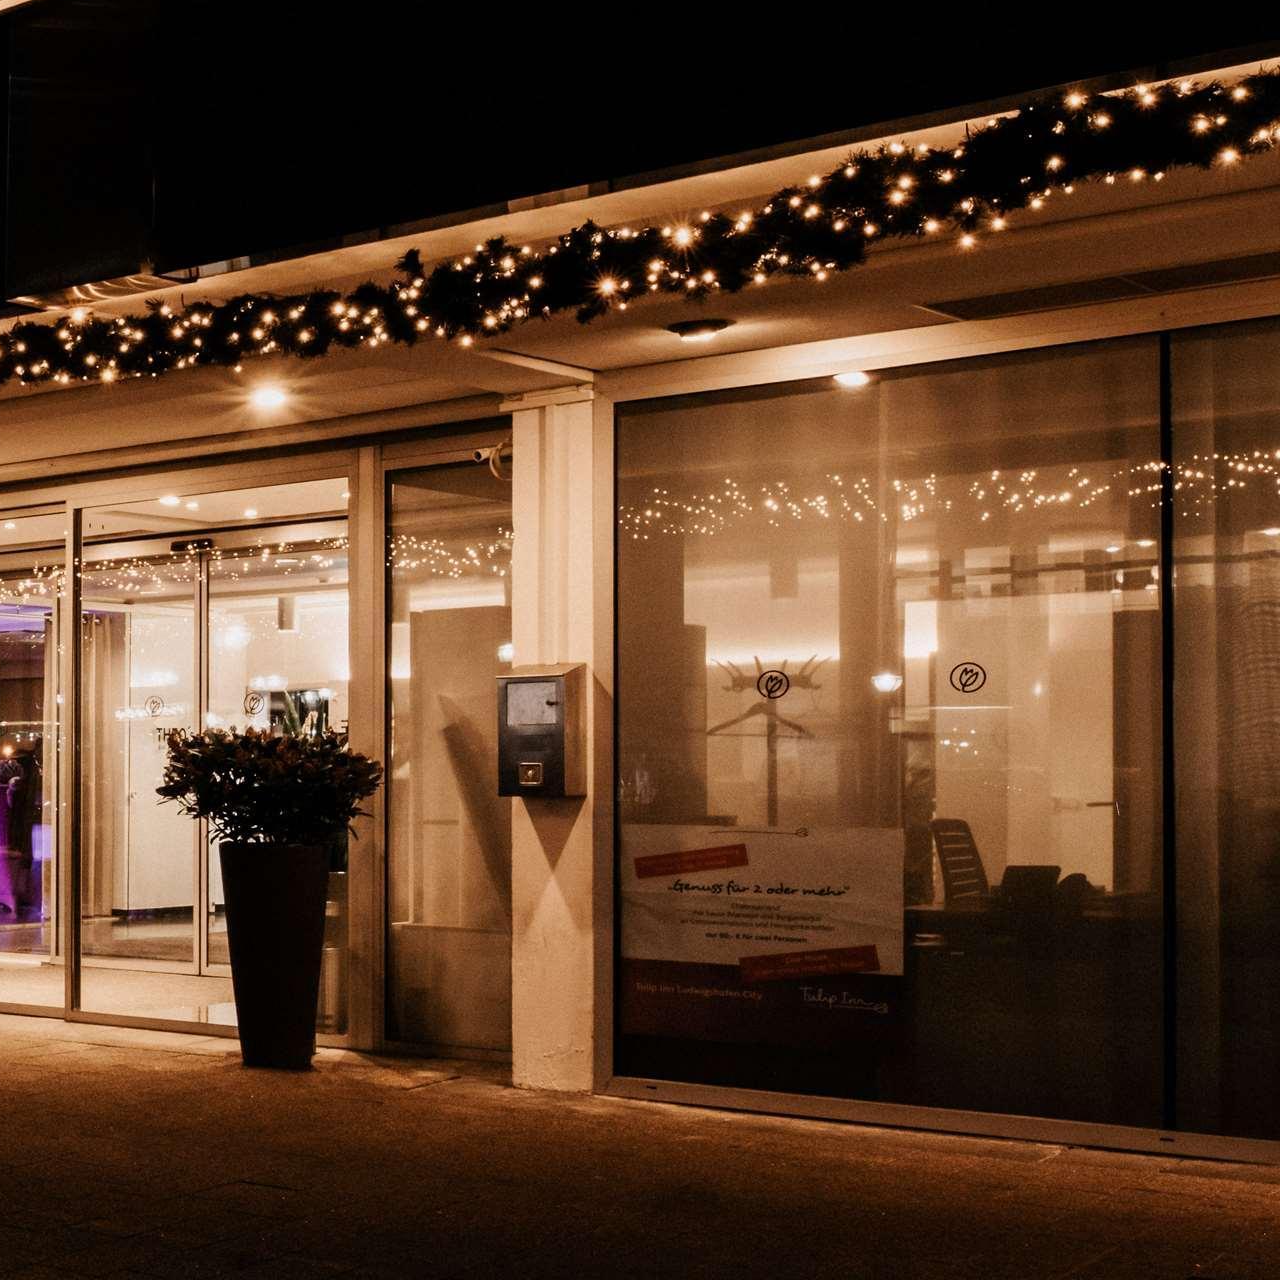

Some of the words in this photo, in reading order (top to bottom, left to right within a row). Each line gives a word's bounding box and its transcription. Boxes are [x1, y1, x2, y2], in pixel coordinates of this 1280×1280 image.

[726, 880, 750, 895] für
[753, 884, 763, 894] 2
[766, 883, 800, 895] oder
